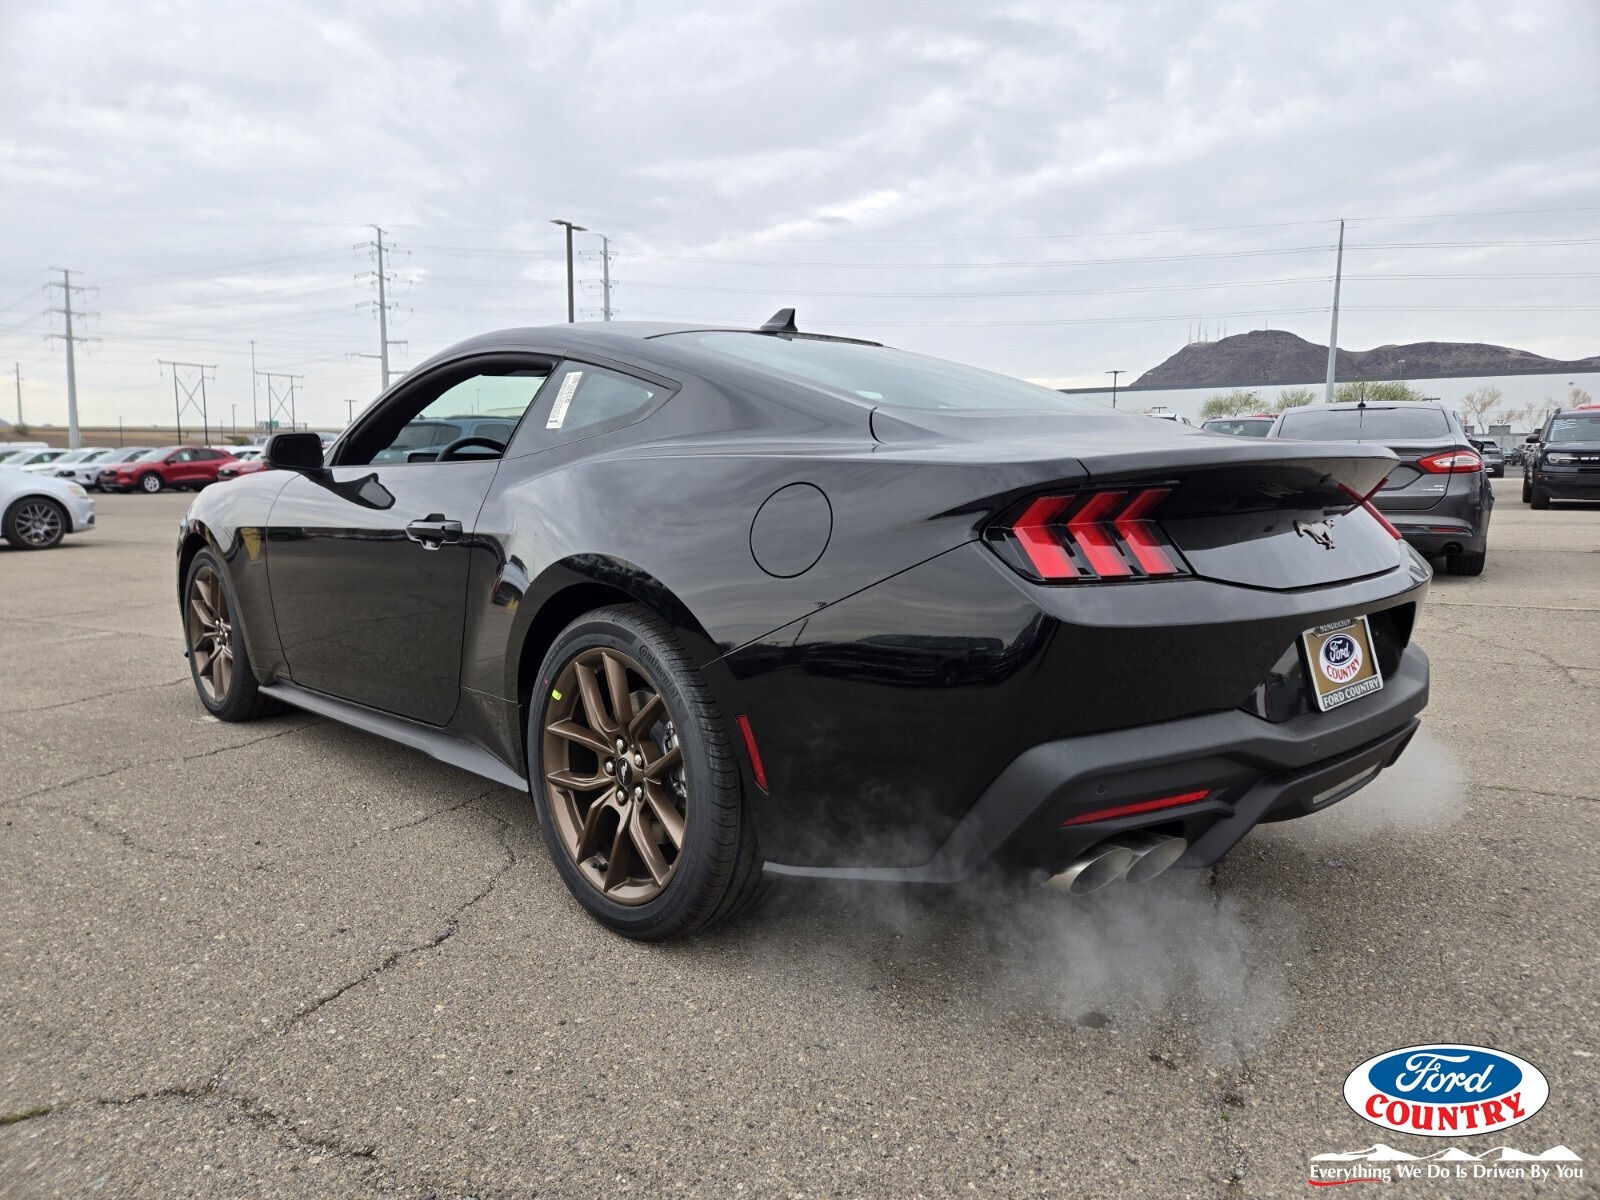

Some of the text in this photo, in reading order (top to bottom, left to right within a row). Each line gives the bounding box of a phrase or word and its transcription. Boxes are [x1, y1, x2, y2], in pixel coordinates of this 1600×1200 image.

[1330, 640, 1350, 661] Ford
[639, 645, 679, 699] Continental
[1327, 656, 1360, 680] COUNTRY
[1323, 679, 1379, 707] FORD COUNTRY
